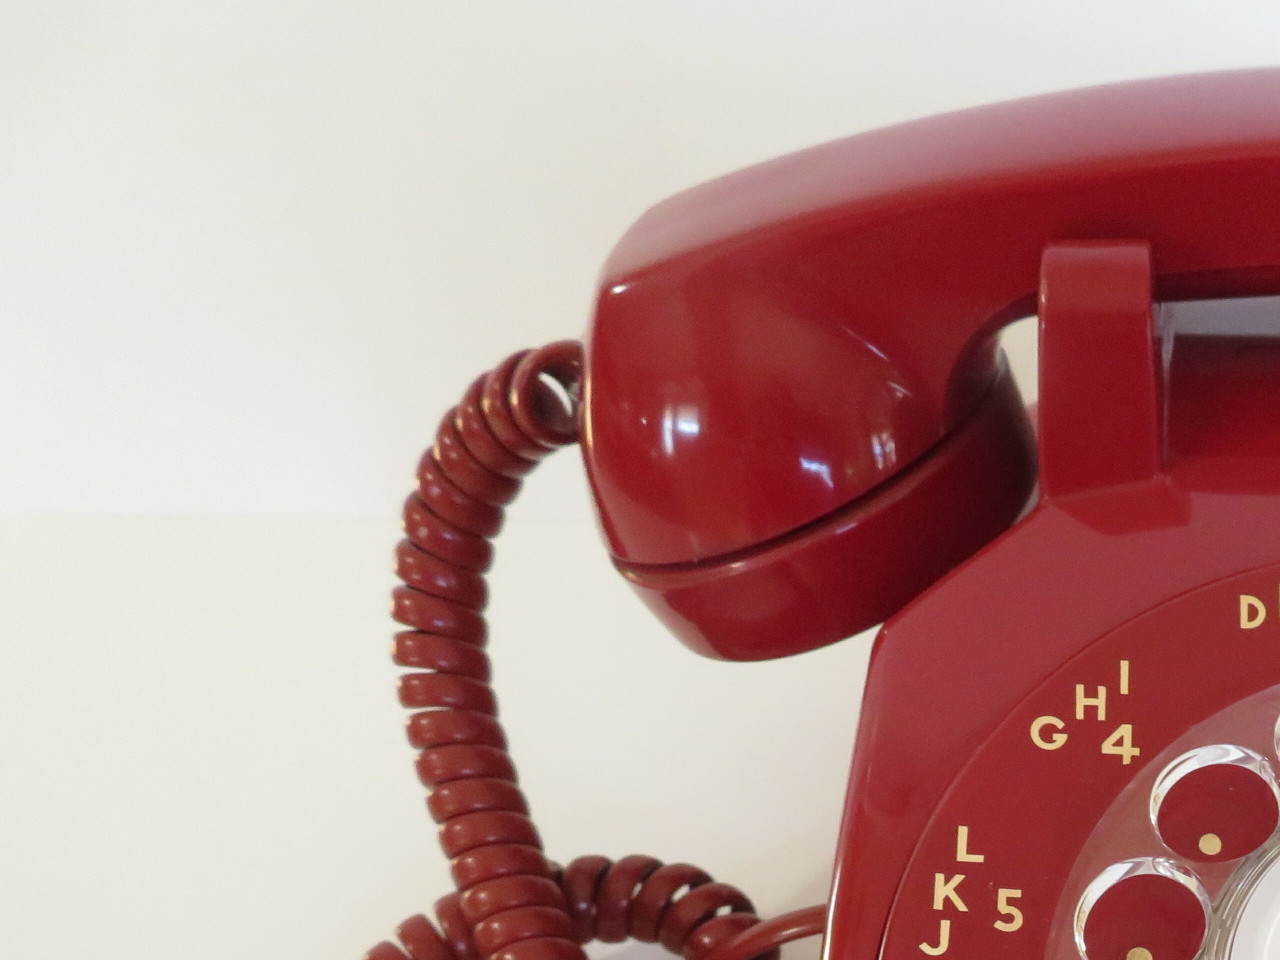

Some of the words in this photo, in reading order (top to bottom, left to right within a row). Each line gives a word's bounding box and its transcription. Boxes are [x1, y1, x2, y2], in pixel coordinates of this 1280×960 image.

[1030, 659, 1129, 751] GHI
[1101, 723, 1140, 765] 4
[993, 888, 1024, 932] 5
